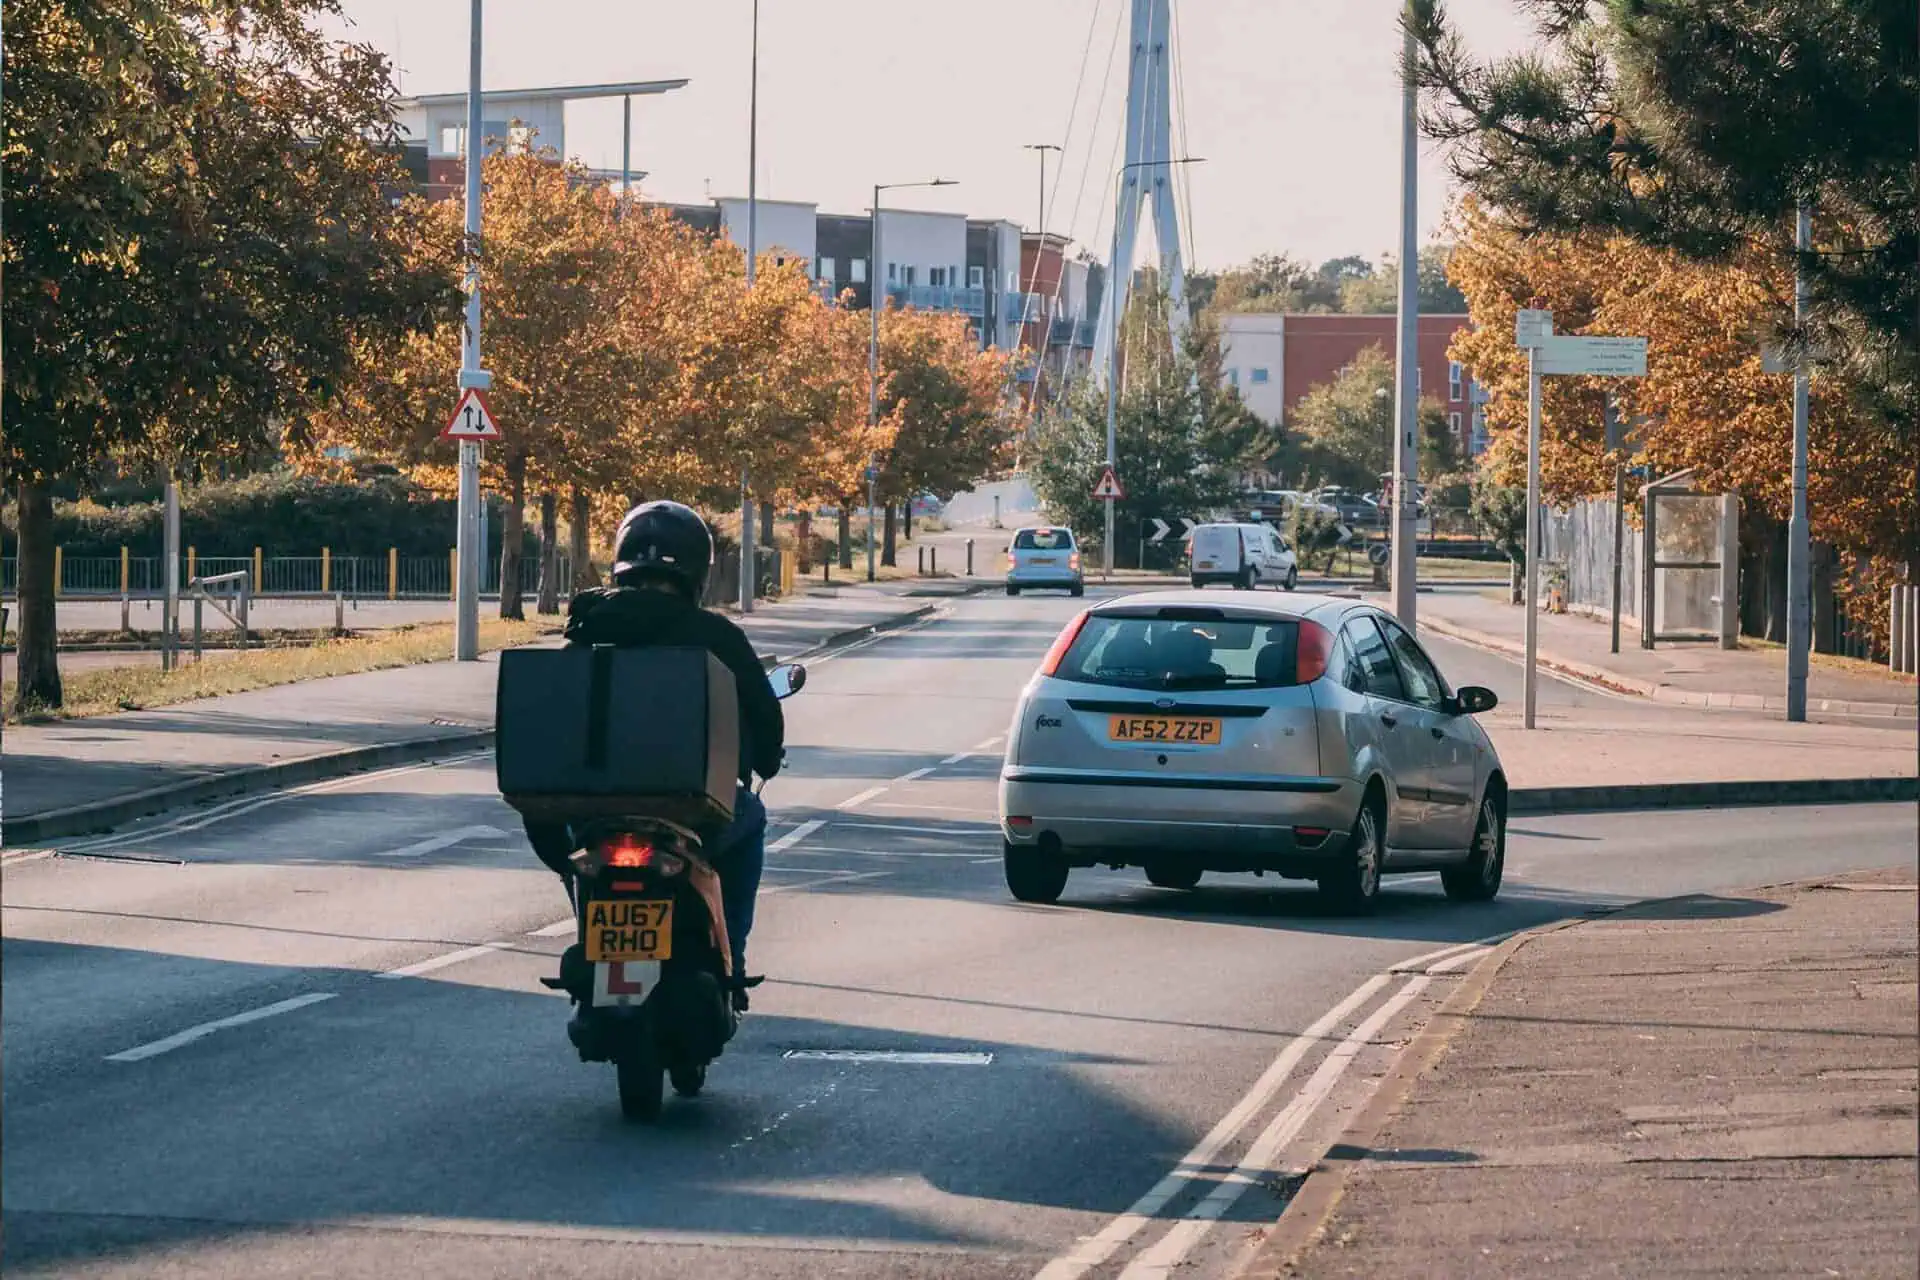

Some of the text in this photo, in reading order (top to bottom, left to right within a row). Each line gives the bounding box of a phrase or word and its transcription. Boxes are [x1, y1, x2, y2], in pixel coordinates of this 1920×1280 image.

[1116, 719, 1214, 741] AF52 ZZP
[592, 903, 669, 926] AU67
[600, 930, 657, 952] RHO
[608, 960, 641, 994] L
